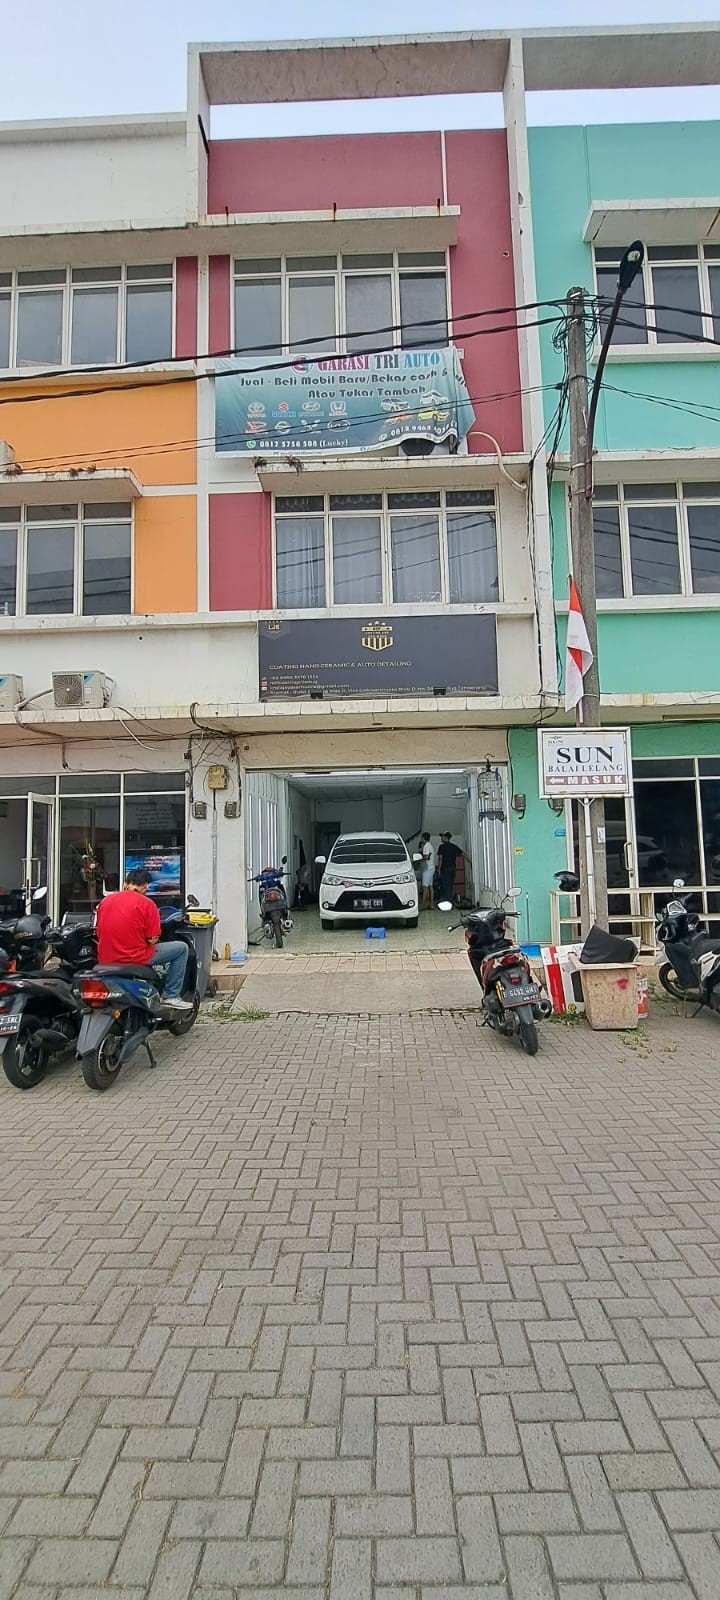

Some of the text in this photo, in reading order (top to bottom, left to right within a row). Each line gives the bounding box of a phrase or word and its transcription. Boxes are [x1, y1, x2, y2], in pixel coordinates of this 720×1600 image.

[317, 352, 440, 371] GARASI TRI AUTO
[241, 378, 264, 386] Jual
[275, 377, 297, 386] Beli
[301, 375, 335, 385] Mobil
[340, 389, 373, 397] Tukar
[377, 386, 426, 396] Tambah
[260, 440, 279, 448] 0817
[320, 439, 348, 448] (Lucky)
[557, 746, 614, 763] SUN
[548, 764, 623, 773] BALAI LELANG
[567, 775, 623, 785] MASUK
